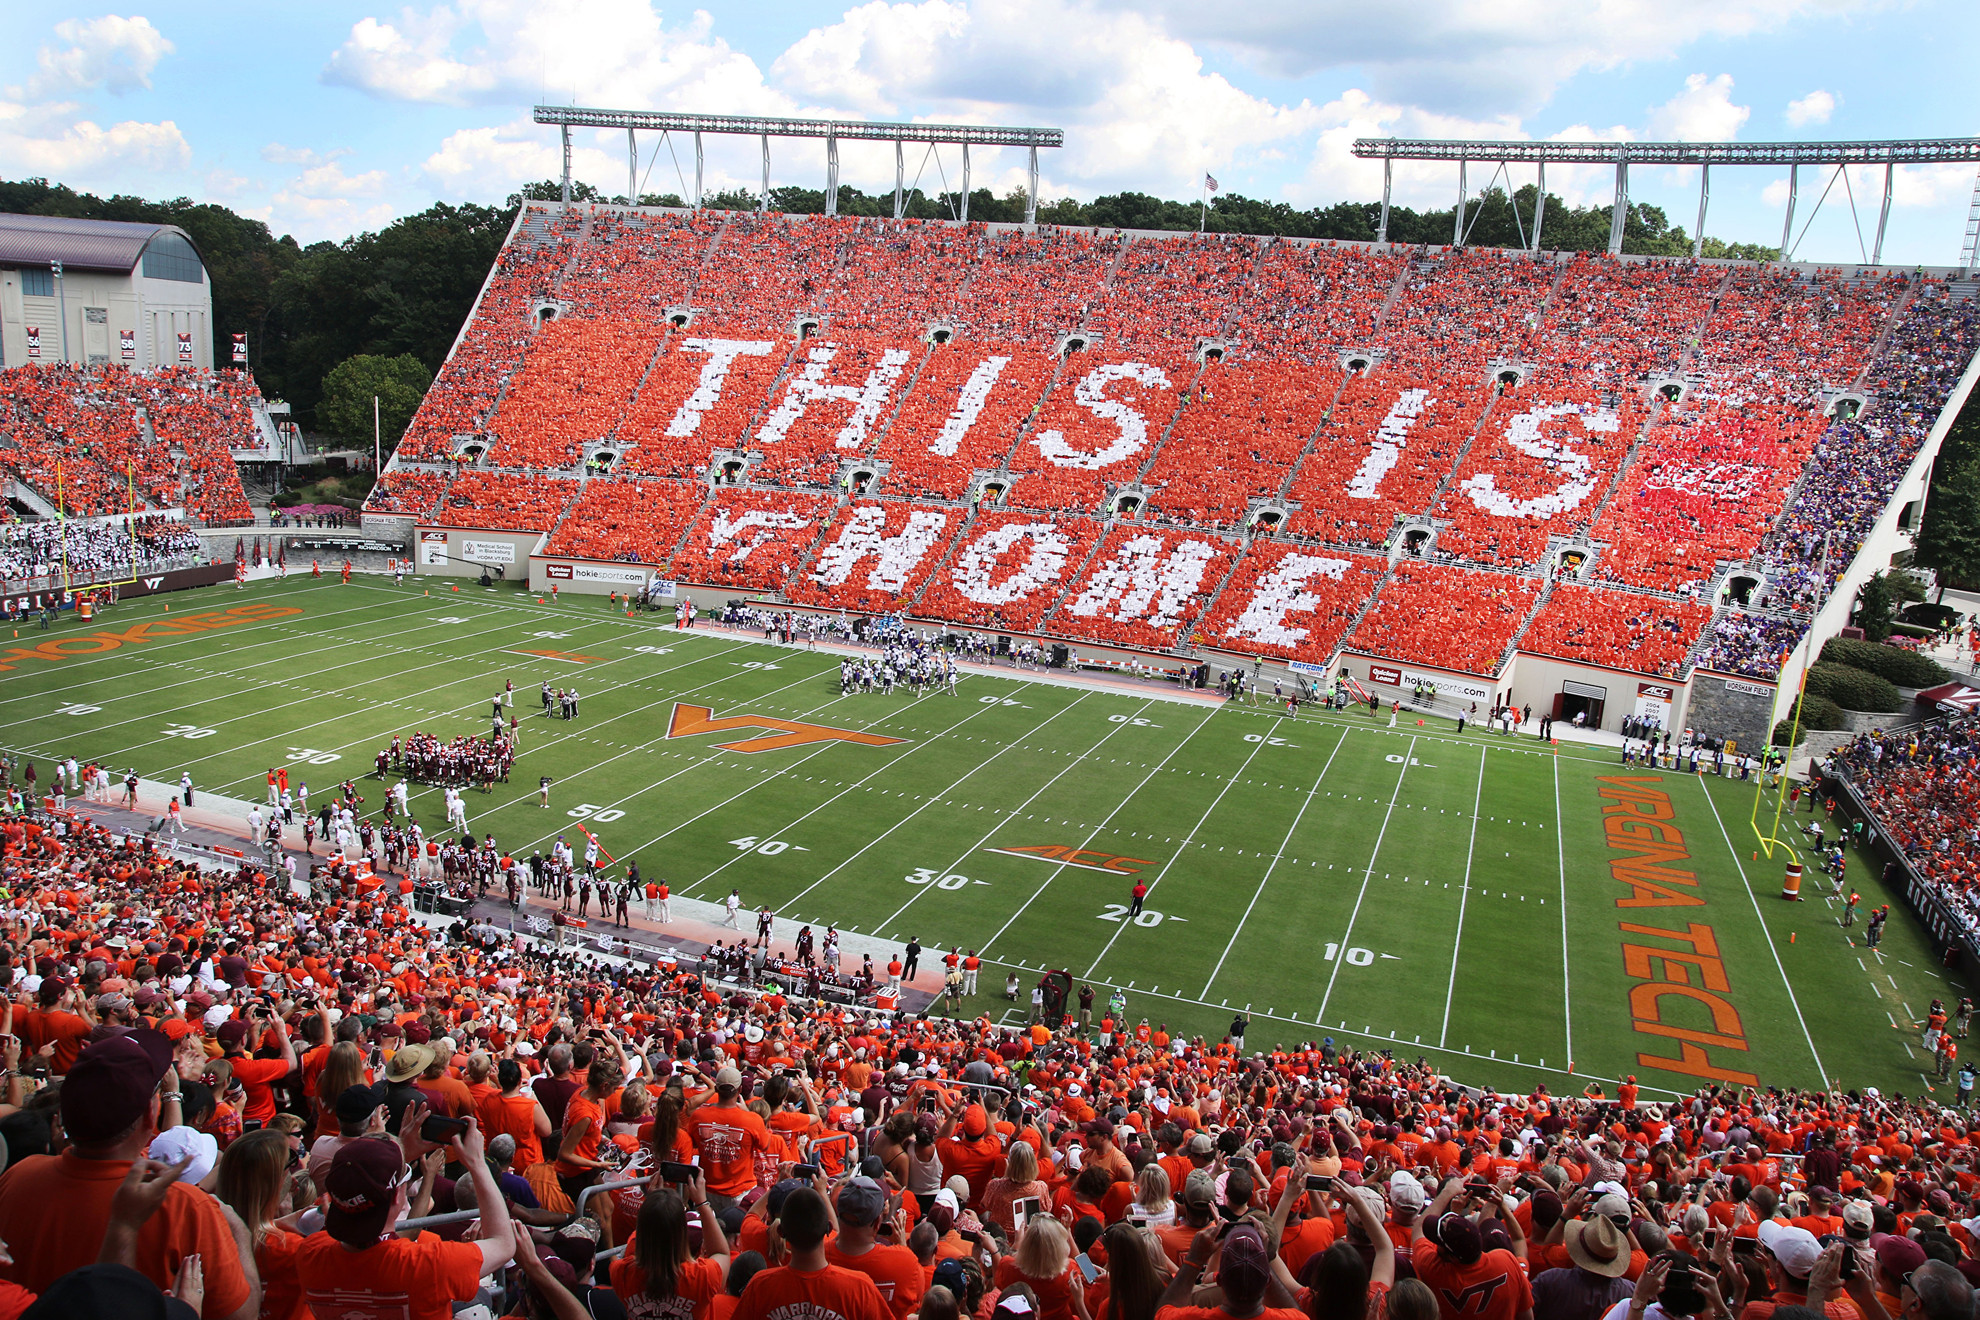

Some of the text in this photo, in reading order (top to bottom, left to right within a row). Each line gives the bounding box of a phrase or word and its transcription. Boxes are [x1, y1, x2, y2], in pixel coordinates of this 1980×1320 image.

[28, 336, 40, 347] 56
[121, 339, 134, 349] 58
[178, 341, 191, 352] 73
[233, 342, 246, 353] 78
[664, 338, 1621, 519] THIS IS
[346, 510, 360, 520] 25
[423, 532, 445, 541] ACC
[484, 548, 511, 556] Blacksburg
[576, 569, 643, 582] hokiesports.com
[807, 505, 1352, 648] HOME
[143, 576, 165, 590] VT
[652, 580, 674, 588] ACC
[1291, 661, 1324, 672] RAYCOM
[1372, 667, 1400, 678] Quicken
[1307, 670, 1321, 678] Sports
[1375, 674, 1396, 684] Loans
[1404, 674, 1487, 699] hokiesports.com
[1643, 686, 1670, 698] ACC
[1726, 682, 1769, 696] WORSHAM FIELD
[54, 703, 103, 716] 10
[160, 724, 218, 740] 20
[665, 701, 915, 754] VT
[286, 749, 342, 765] 30
[565, 802, 627, 824] 50
[1867, 826, 1878, 845] VT
[727, 835, 791, 857] 40
[1000, 844, 1161, 873] ACC
[904, 866, 969, 891] 30
[1096, 903, 1165, 928] 20
[1906, 878, 1947, 942] HOKIES
[762, 913, 772, 923] 87
[1594, 775, 1762, 1089] VIRGINIA TECH
[711, 946, 721, 956] 85
[1322, 941, 1375, 967] 10
[773, 961, 783, 970] 69
[824, 975, 834, 984] 72
[851, 979, 861, 988] 71
[379, 1233, 390, 1242] VT
[1440, 1272, 1508, 1314] VT
